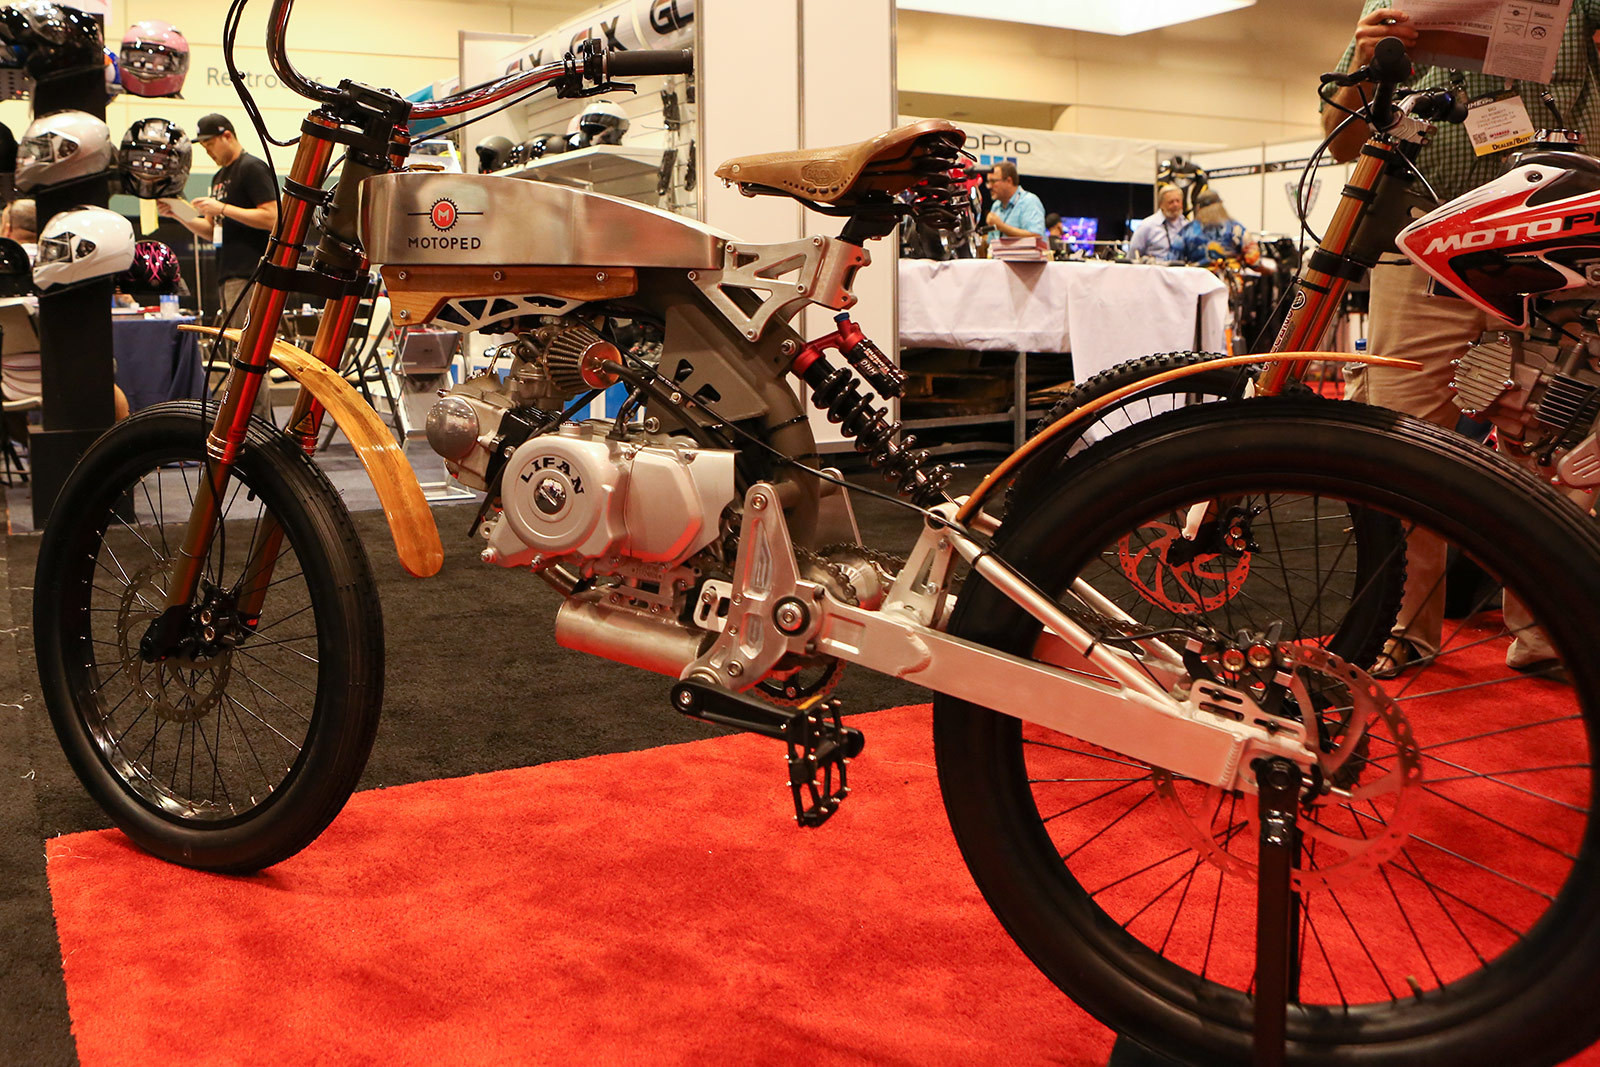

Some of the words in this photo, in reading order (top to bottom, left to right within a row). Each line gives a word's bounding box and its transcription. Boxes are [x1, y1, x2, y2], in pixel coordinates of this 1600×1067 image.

[649, 0, 694, 34] GL
[206, 66, 323, 89] Retro
[963, 133, 1031, 154] oPro
[437, 208, 450, 222] M
[407, 236, 482, 250] MOTOPED
[1422, 211, 1600, 256] MOTOP
[520, 457, 585, 495] LIFAN
